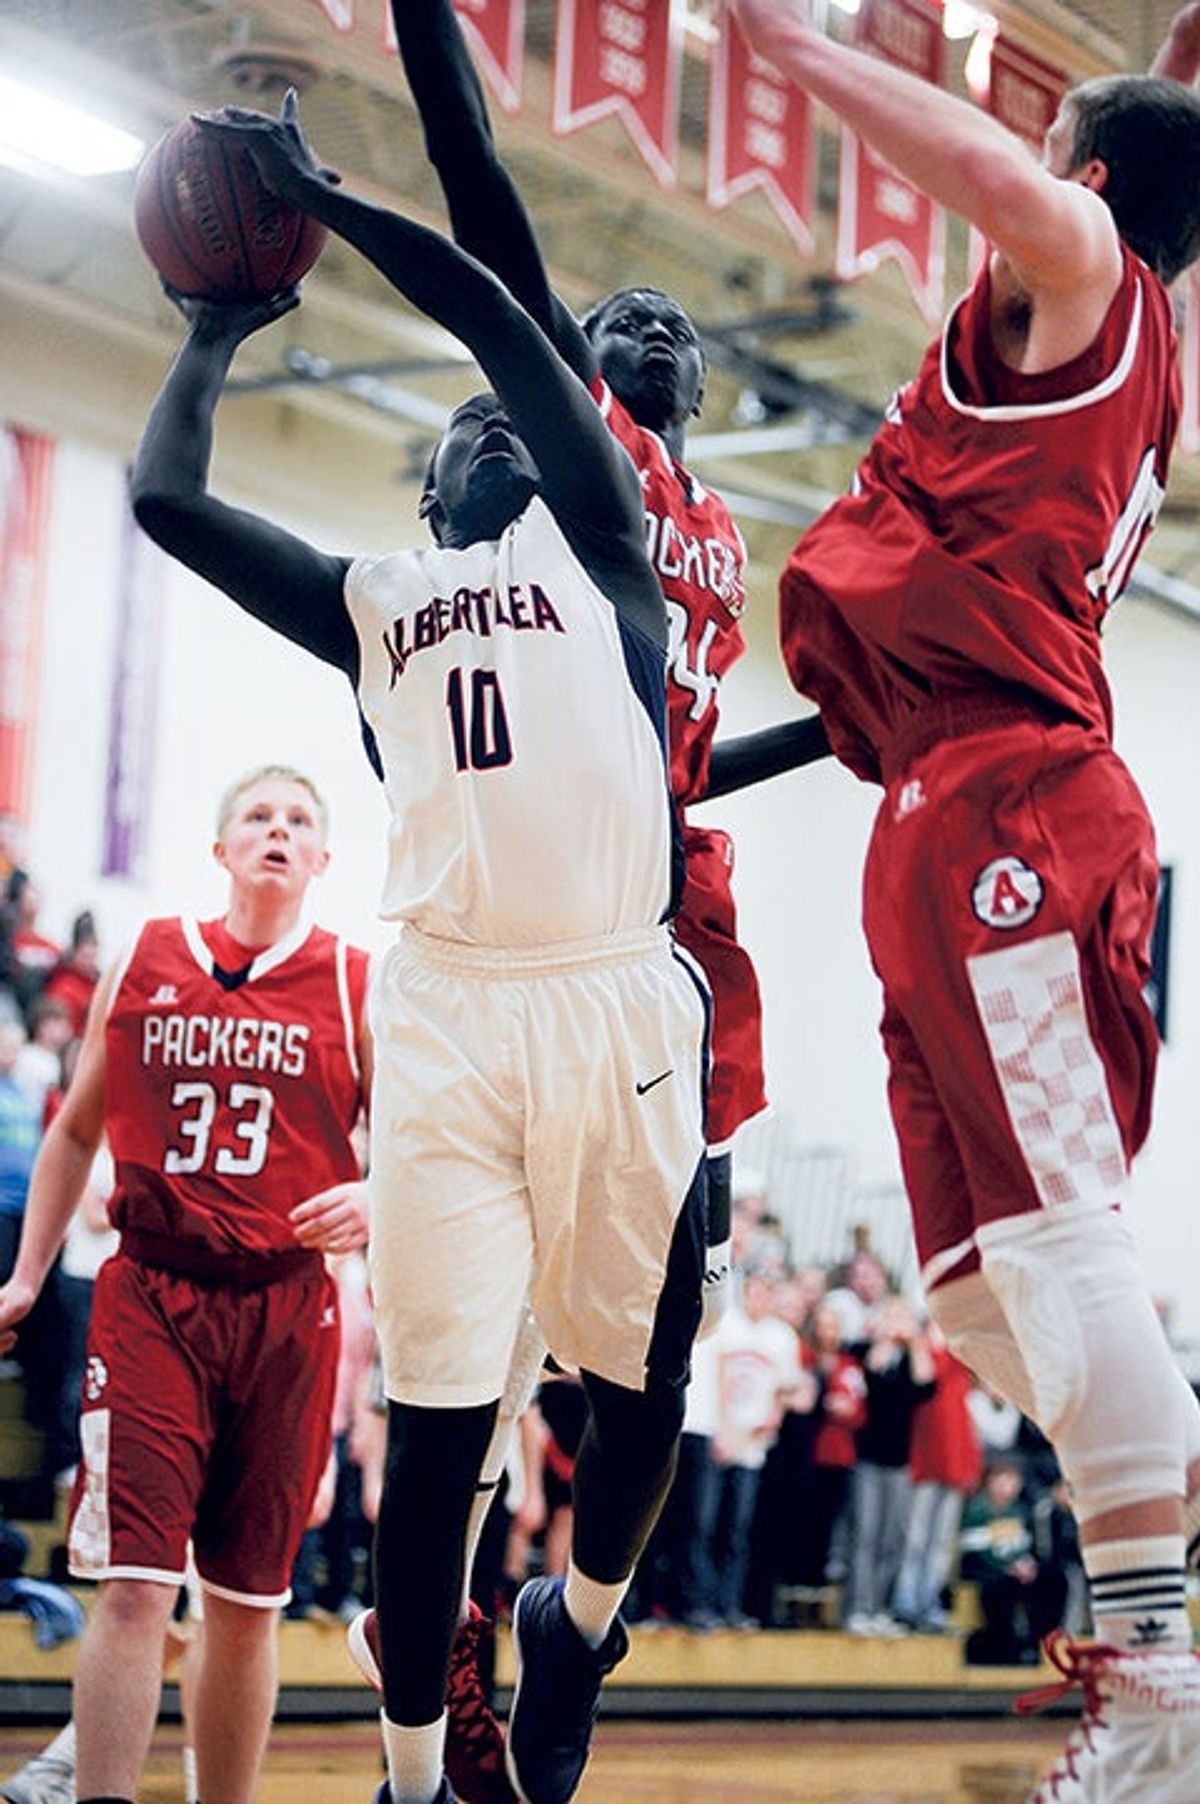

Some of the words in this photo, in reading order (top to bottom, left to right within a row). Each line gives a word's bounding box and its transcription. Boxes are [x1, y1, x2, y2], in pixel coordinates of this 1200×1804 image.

[446, 666, 513, 772] 10
[990, 869, 1030, 916] A
[142, 1014, 310, 1077] PACKERS
[163, 1082, 274, 1176] 33
